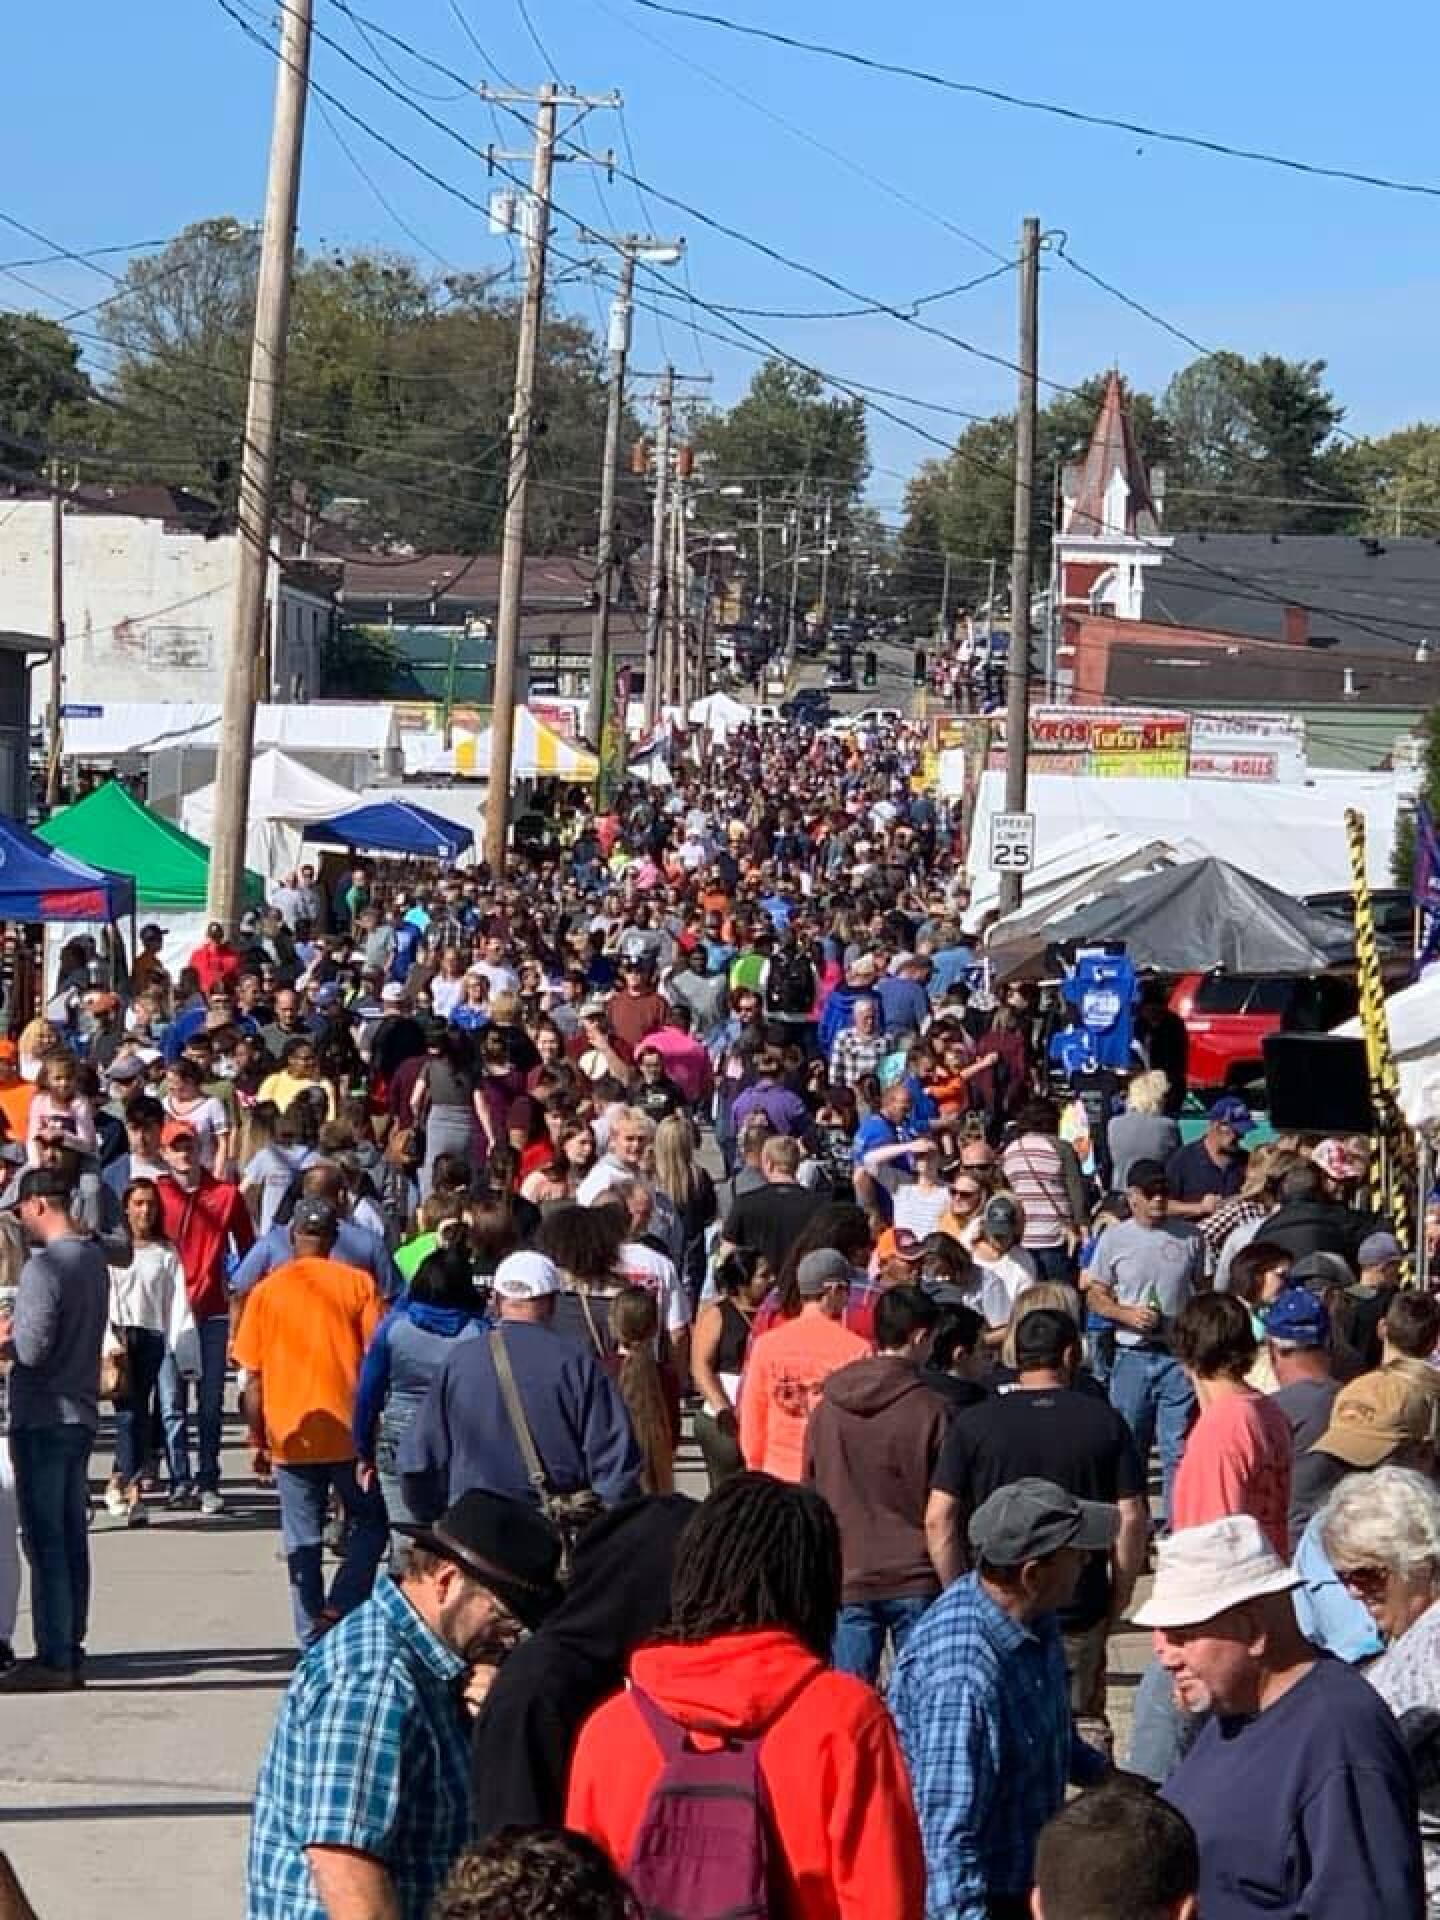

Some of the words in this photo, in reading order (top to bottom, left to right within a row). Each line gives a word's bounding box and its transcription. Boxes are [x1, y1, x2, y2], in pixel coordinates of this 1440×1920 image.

[995, 817, 1031, 829] SPEED
[997, 831, 1027, 842] LIMIT
[993, 844, 1029, 866] 25
